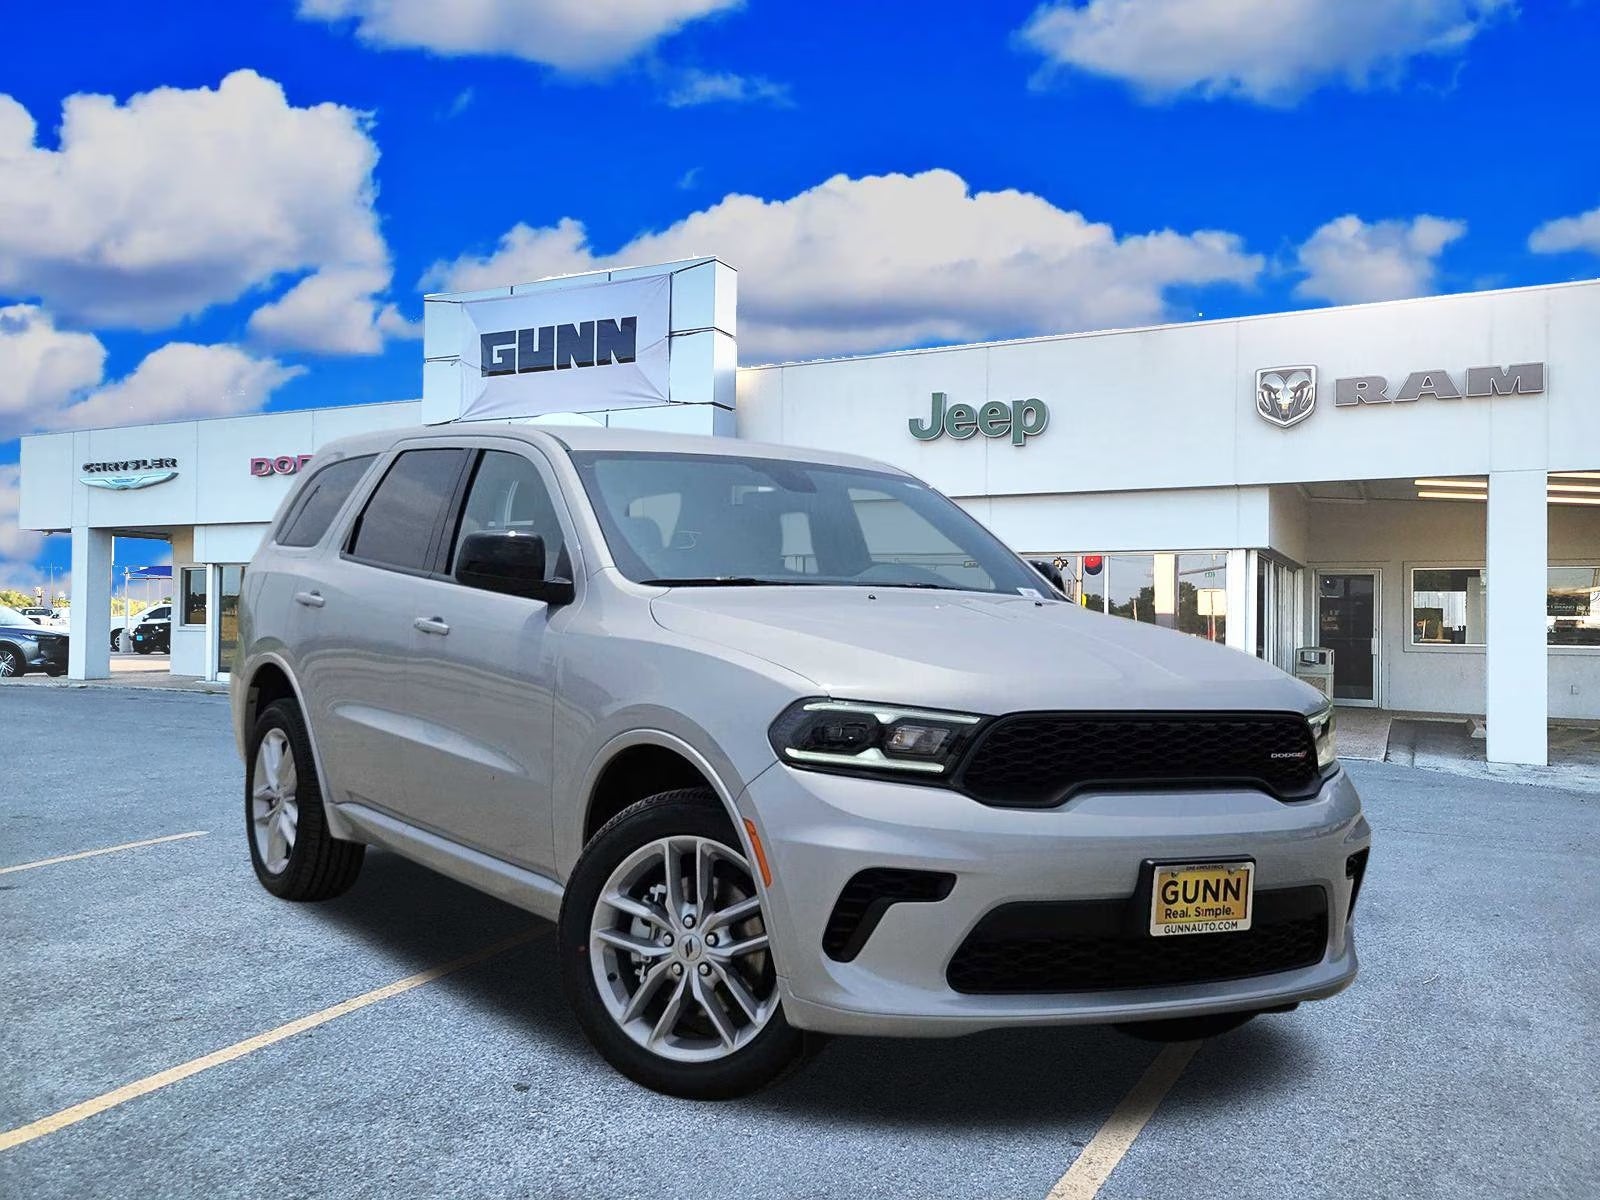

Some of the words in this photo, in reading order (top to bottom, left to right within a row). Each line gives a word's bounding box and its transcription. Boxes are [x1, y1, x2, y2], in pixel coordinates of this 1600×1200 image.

[480, 316, 637, 378] GUNN
[1335, 362, 1545, 407] RAM
[908, 392, 1049, 446] Jeep
[82, 458, 178, 473] CHRYSLER
[1161, 877, 1242, 905] GUNN
[1164, 907, 1191, 919] Real.
[1164, 921, 1238, 934] GUNNAUTO.COM
